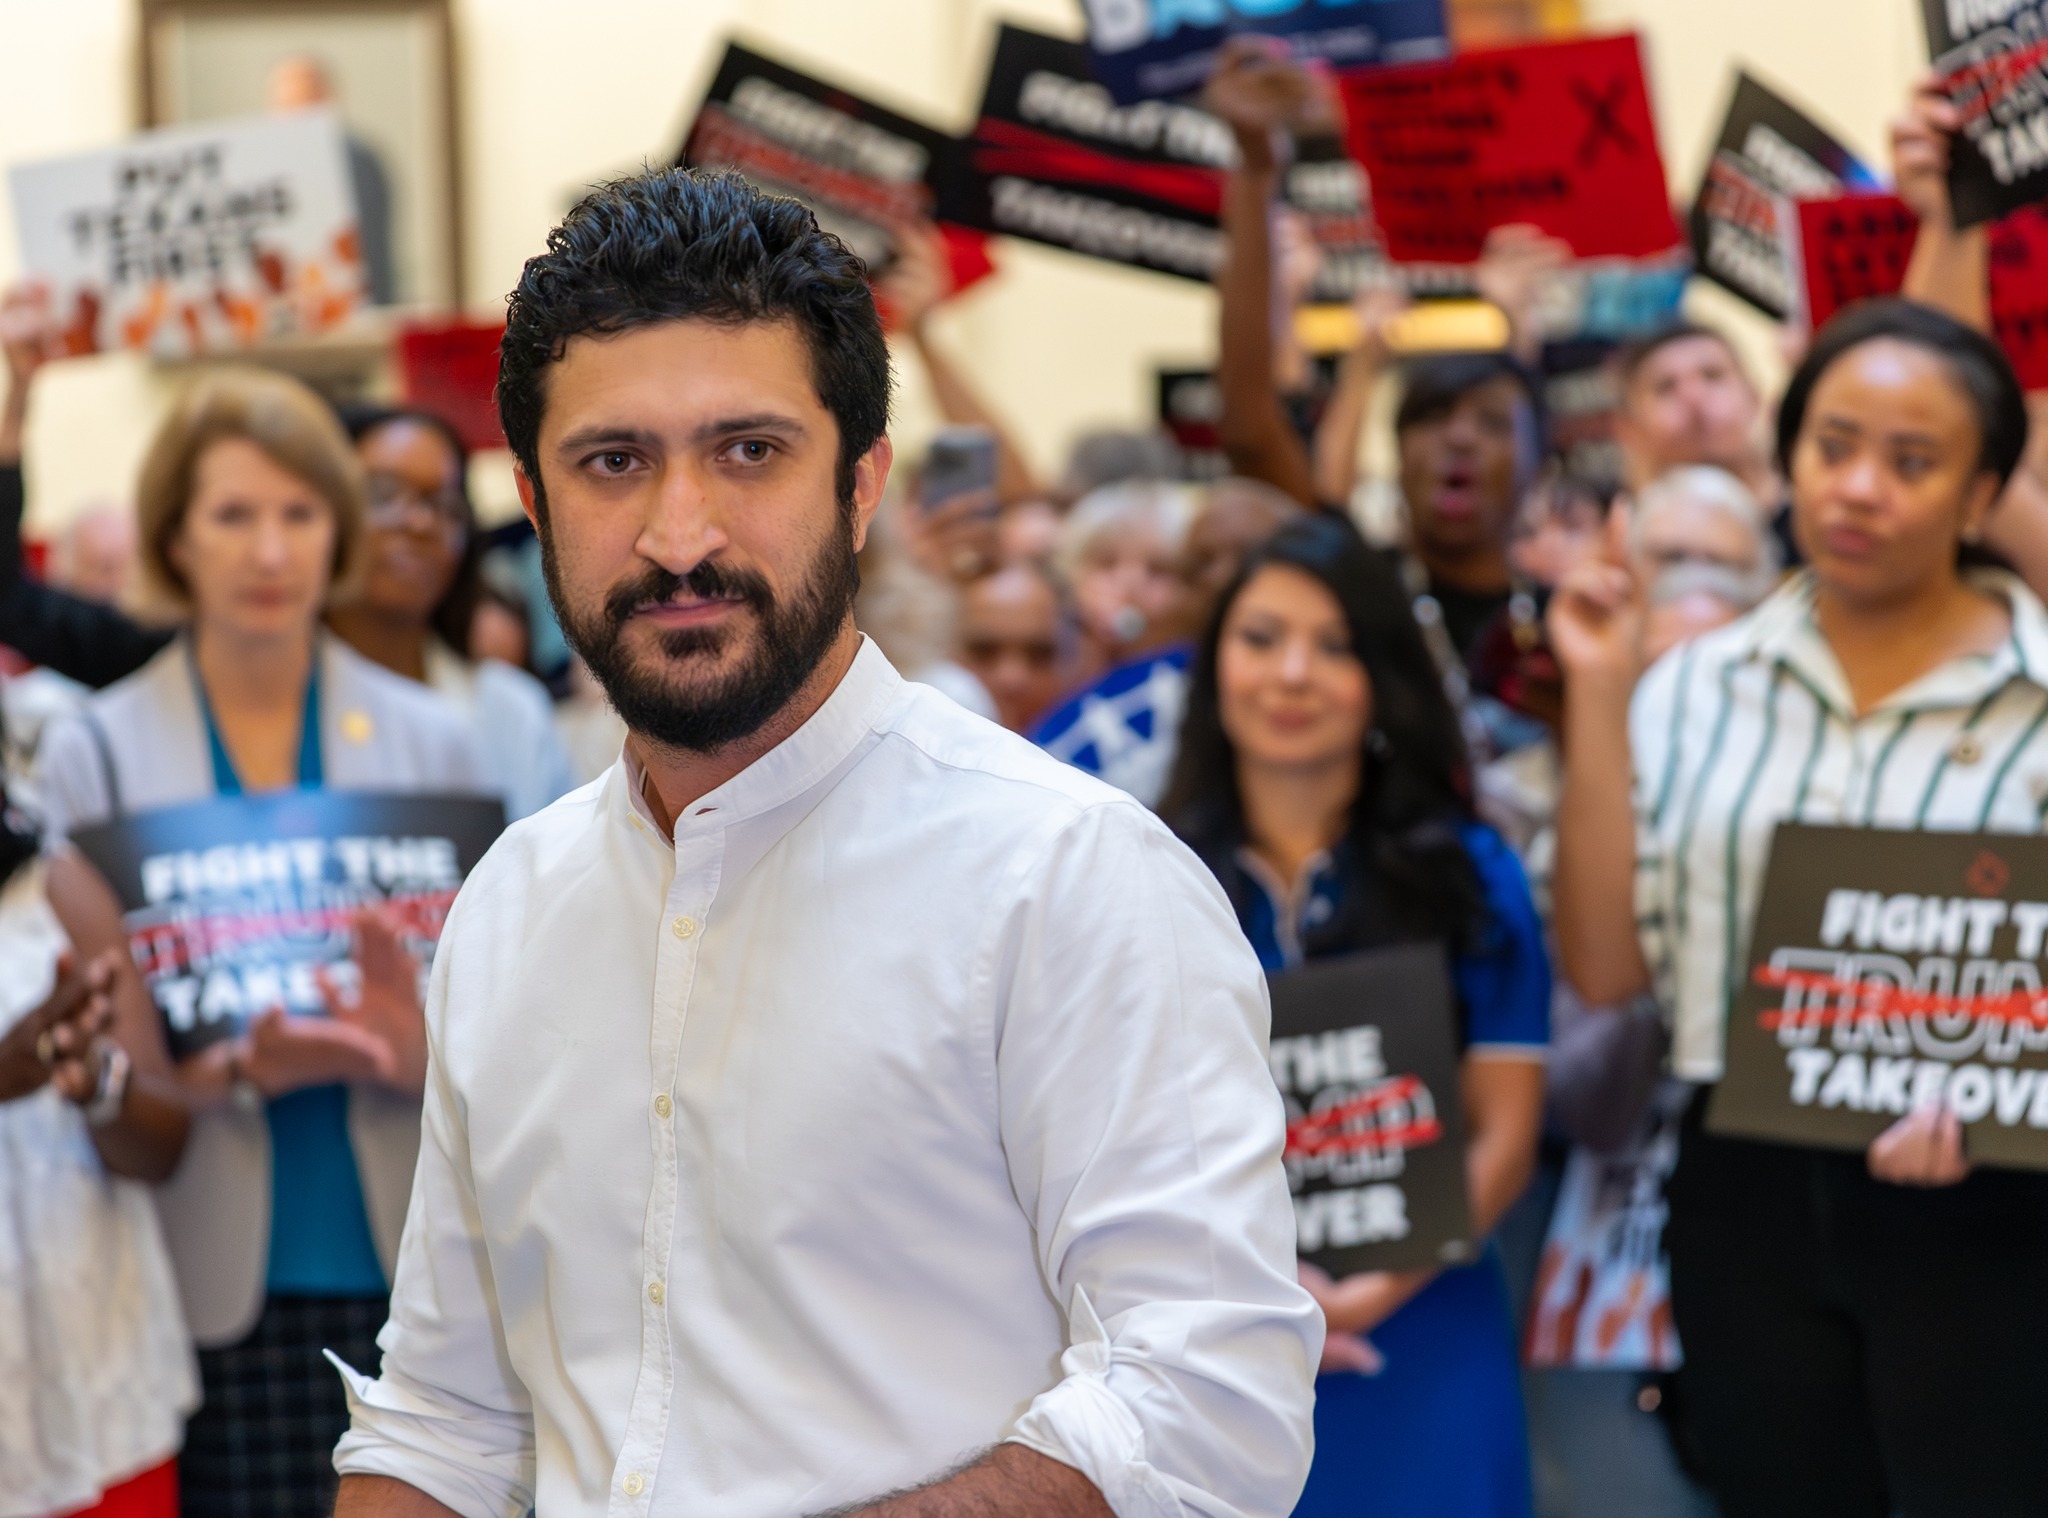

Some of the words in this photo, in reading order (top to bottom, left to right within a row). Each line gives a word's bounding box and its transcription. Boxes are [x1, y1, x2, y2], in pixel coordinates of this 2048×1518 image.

[117, 143, 222, 194] PUT
[140, 837, 327, 902] FIGHT
[332, 834, 459, 892] THE
[1820, 888, 2008, 958] FIGHT
[2010, 901, 2048, 960] T
[1268, 1024, 1389, 1095] THE
